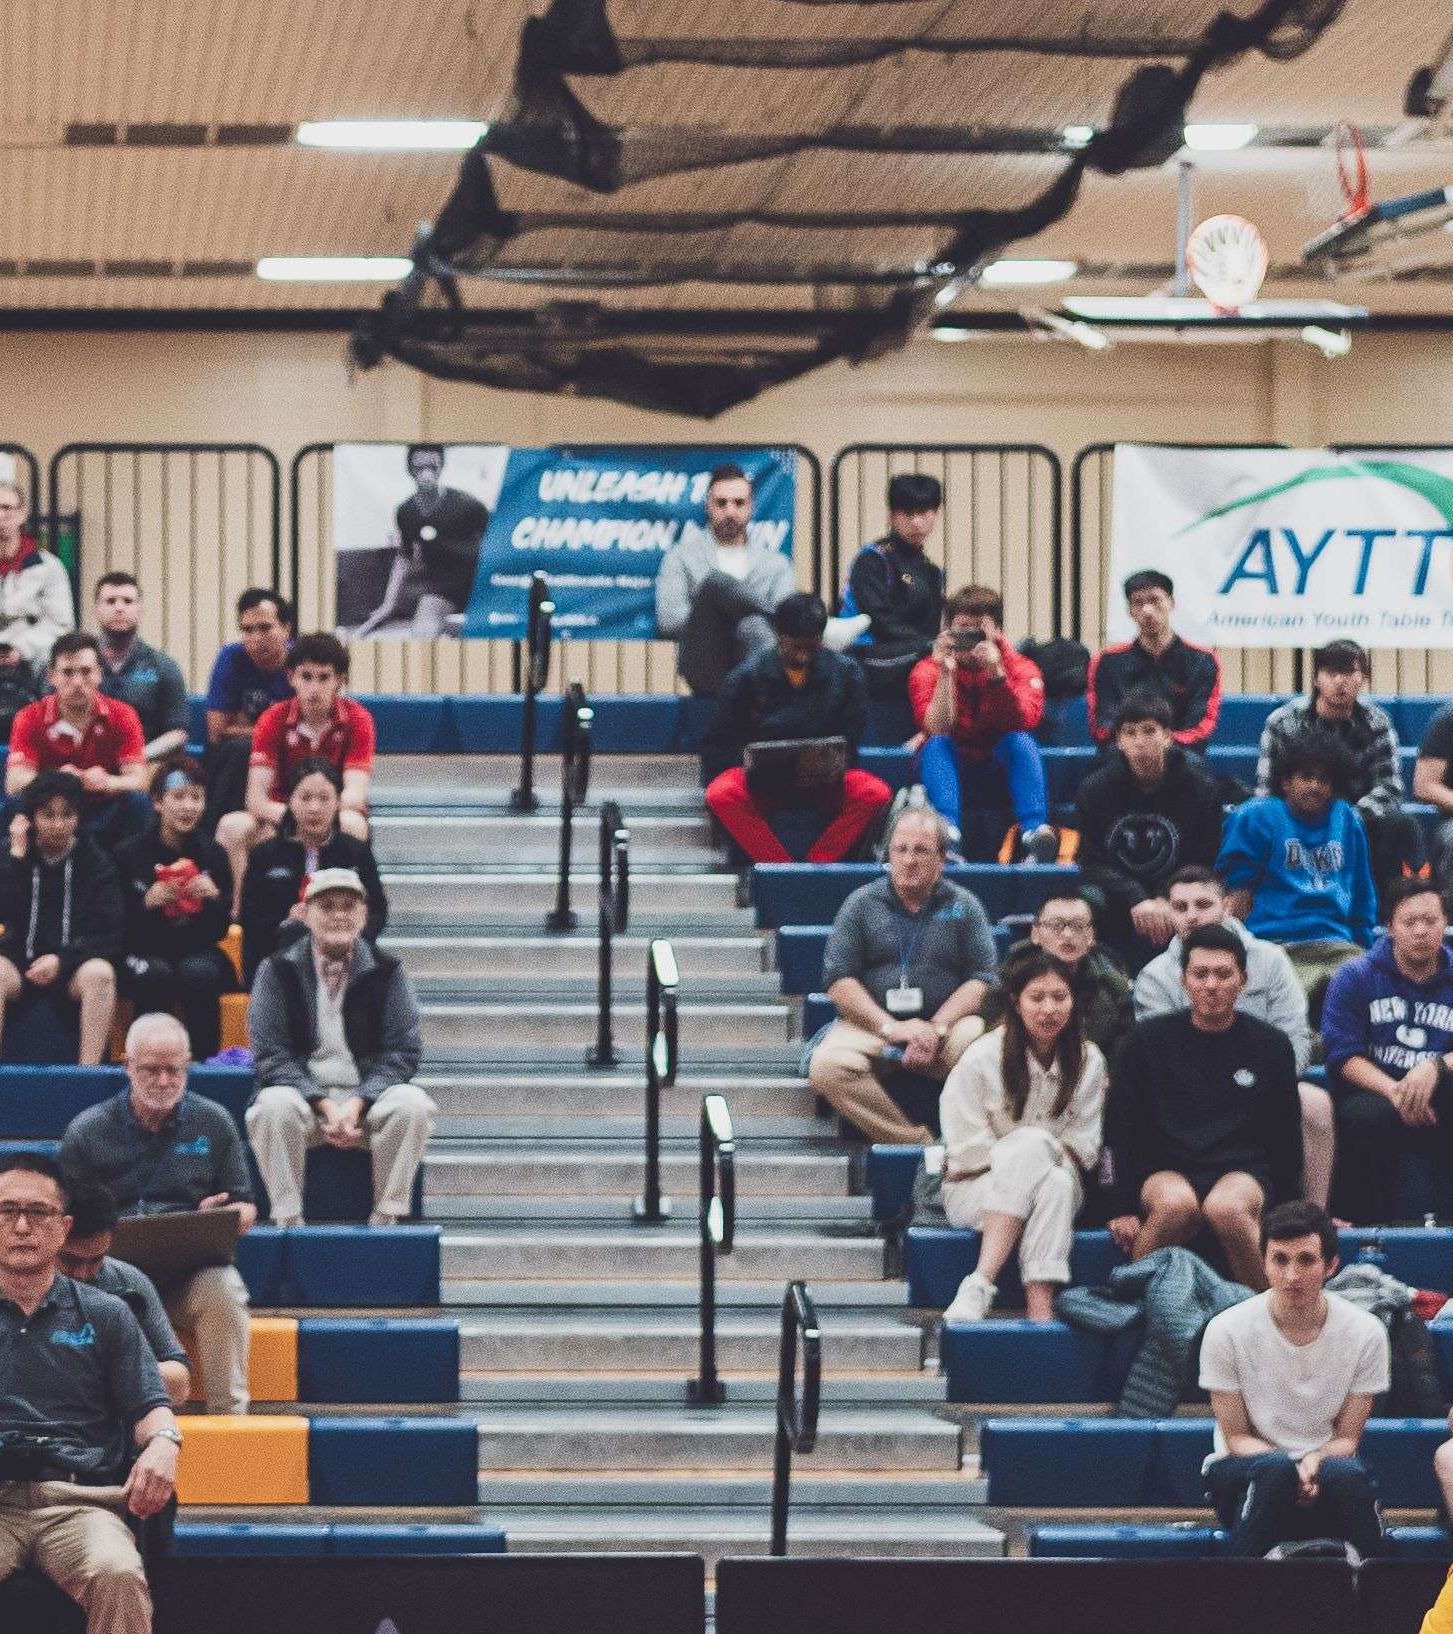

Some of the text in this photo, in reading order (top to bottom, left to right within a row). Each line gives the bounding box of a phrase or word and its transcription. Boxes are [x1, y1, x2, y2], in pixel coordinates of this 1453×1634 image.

[539, 470, 686, 504] UNLEASH
[512, 517, 676, 551] CHAMPION
[1208, 610, 1304, 627] American
[1313, 610, 1370, 627] Youth
[1379, 610, 1431, 627] Table
[1369, 996, 1408, 1025] NEW
